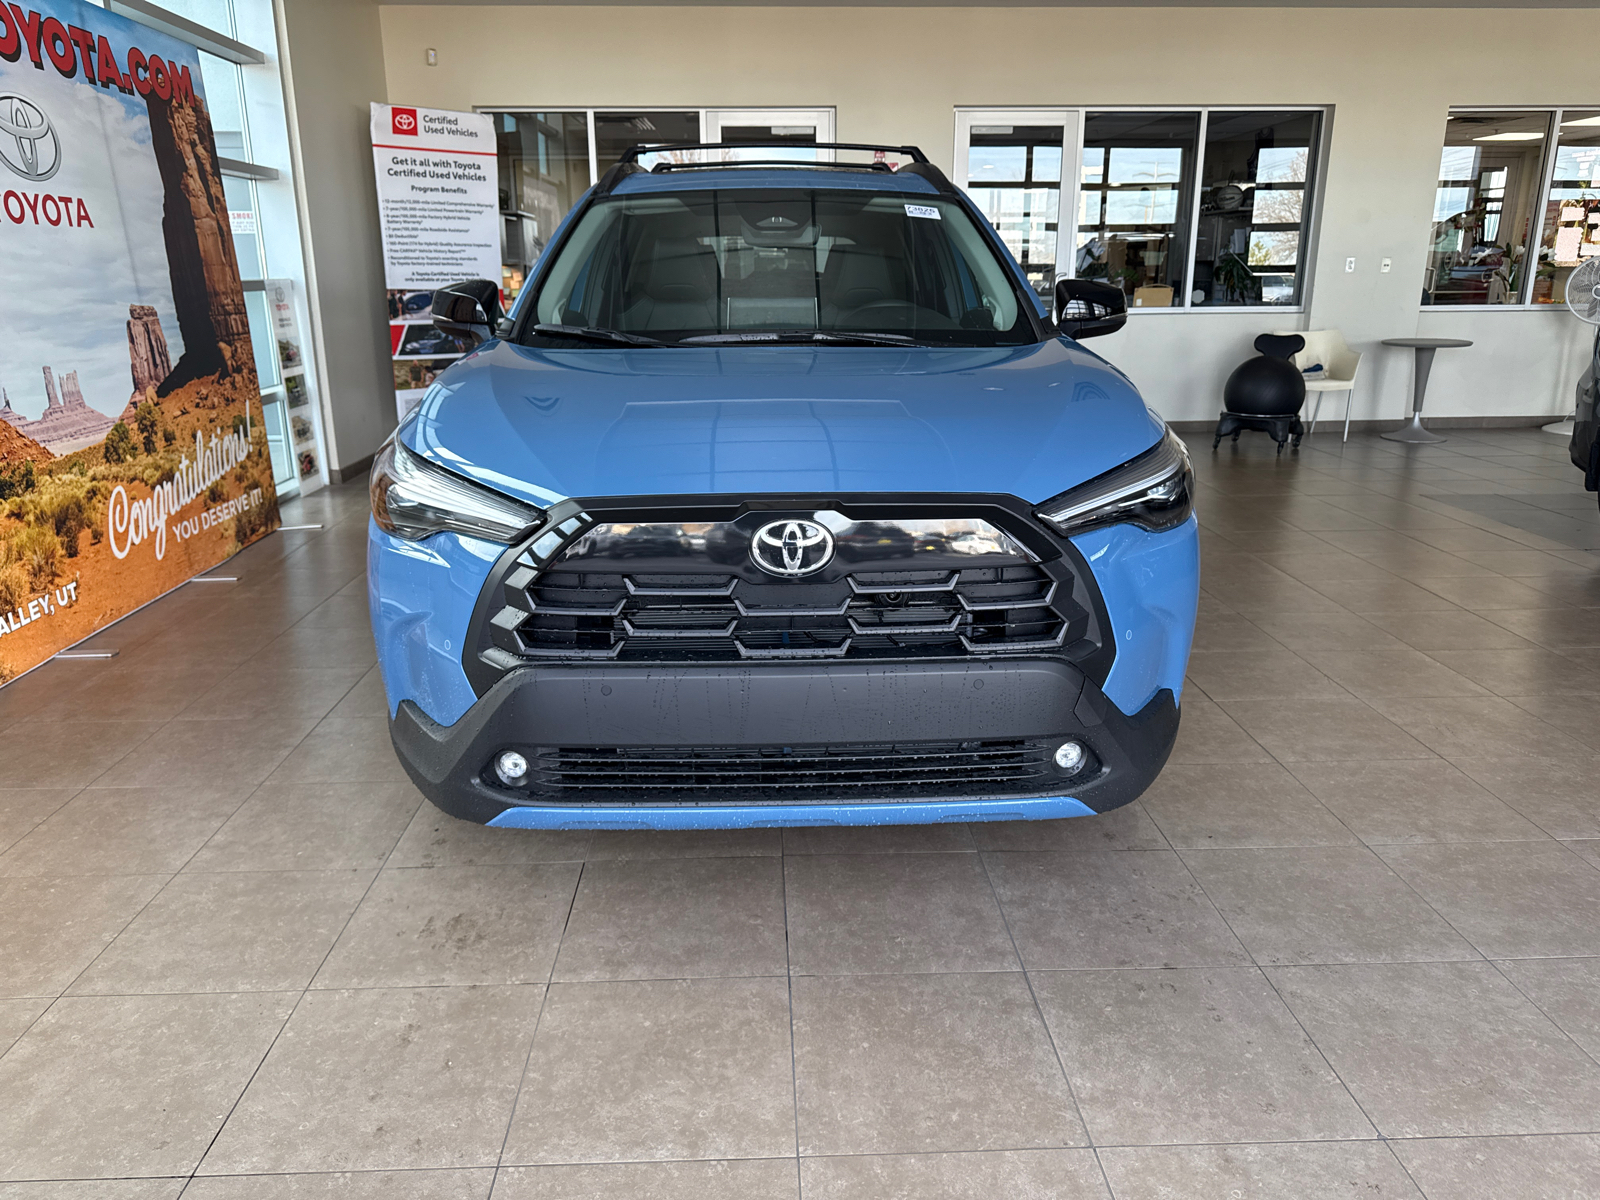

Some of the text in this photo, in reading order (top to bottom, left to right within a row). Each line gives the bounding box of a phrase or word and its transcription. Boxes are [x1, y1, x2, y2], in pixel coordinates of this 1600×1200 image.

[423, 115, 458, 126] Certified
[424, 126, 478, 138] Used Vehicles
[392, 156, 481, 171] Get it all with Toyota
[388, 168, 487, 182] Certified Used Vehicles
[411, 185, 440, 194] Program
[0, 190, 94, 228] OYOTA
[109, 400, 252, 560] Congratulations!
[172, 488, 264, 542] YOU DESERVE IT!
[56, 582, 76, 606] UT
